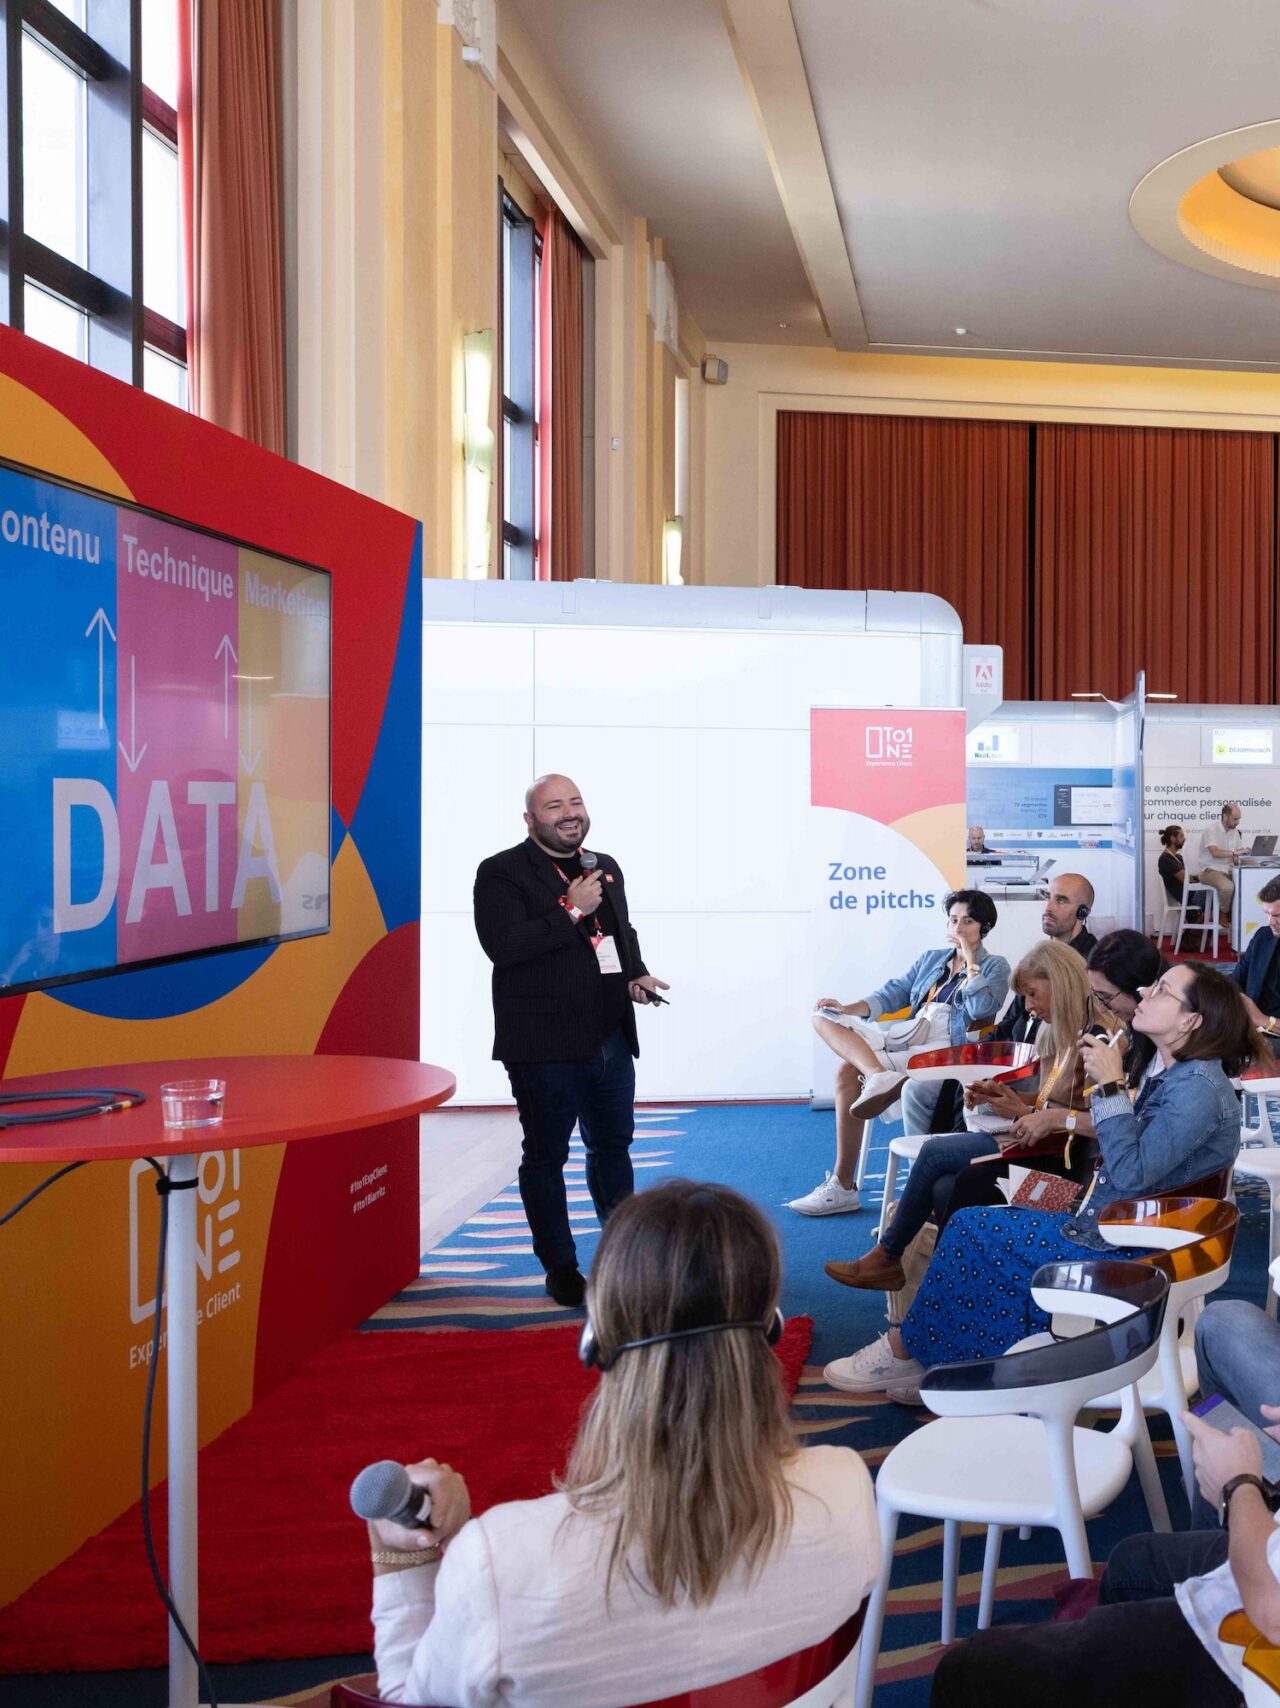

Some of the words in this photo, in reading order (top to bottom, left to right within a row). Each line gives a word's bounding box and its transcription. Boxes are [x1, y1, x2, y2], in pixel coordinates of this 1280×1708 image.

[122, 534, 235, 602] Technique
[1154, 783, 1212, 795] expérience
[1200, 796, 1272, 809] personnalisée
[1157, 810, 1197, 822] chaque
[1199, 810, 1224, 821] clien
[53, 777, 282, 935] DATA
[828, 862, 887, 881] Zone
[829, 890, 858, 910] de
[866, 889, 936, 916] pitchs
[350, 1164, 388, 1194] #1to1ExpClient
[353, 1186, 386, 1214] #1to1Biarritz
[206, 1282, 242, 1319] Client
